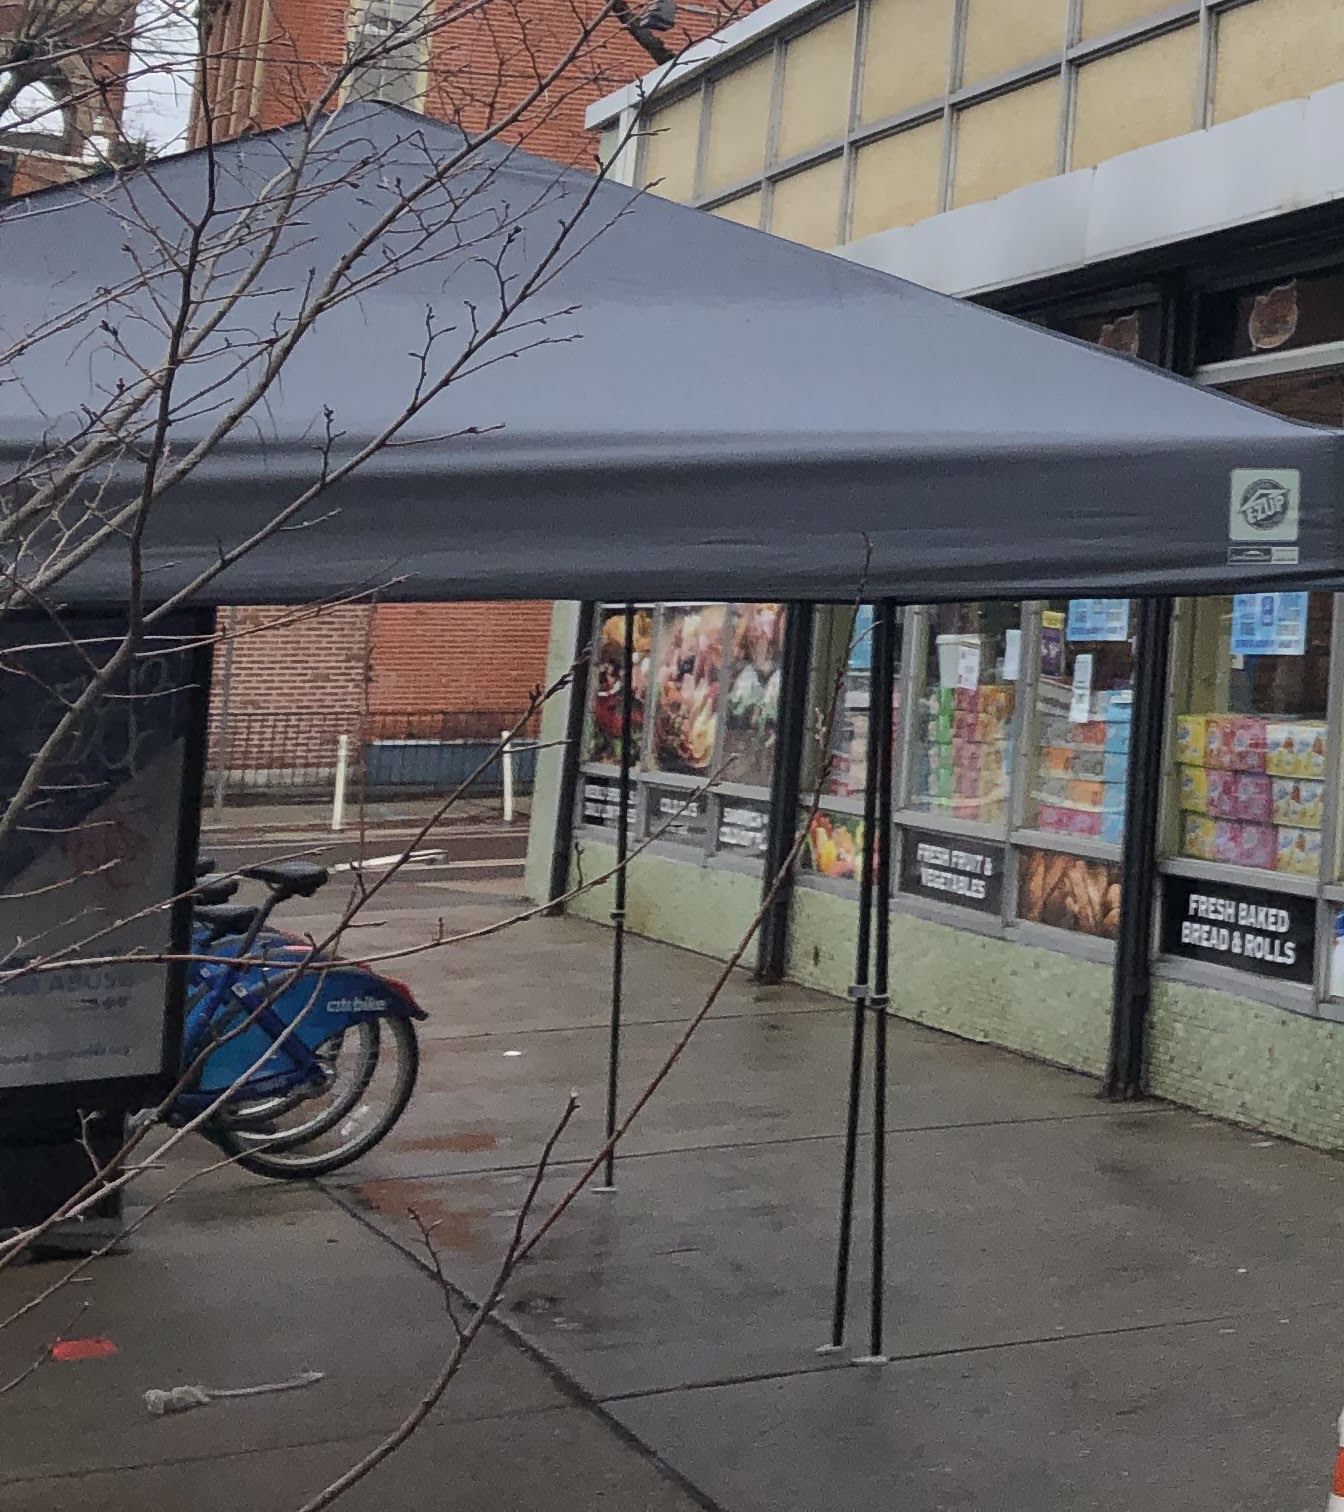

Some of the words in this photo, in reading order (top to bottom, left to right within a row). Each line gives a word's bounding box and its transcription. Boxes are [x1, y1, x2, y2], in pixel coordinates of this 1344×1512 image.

[917, 843, 950, 867] FRESH
[950, 850, 984, 875] FRUIT
[984, 857, 993, 876] &
[920, 867, 987, 899] VEGETABLES
[1188, 894, 1236, 922] FRESH
[1238, 903, 1290, 932] BAKED
[1181, 921, 1230, 950] BREAD
[1231, 931, 1243, 953] &
[1244, 934, 1297, 965] ROLLS
